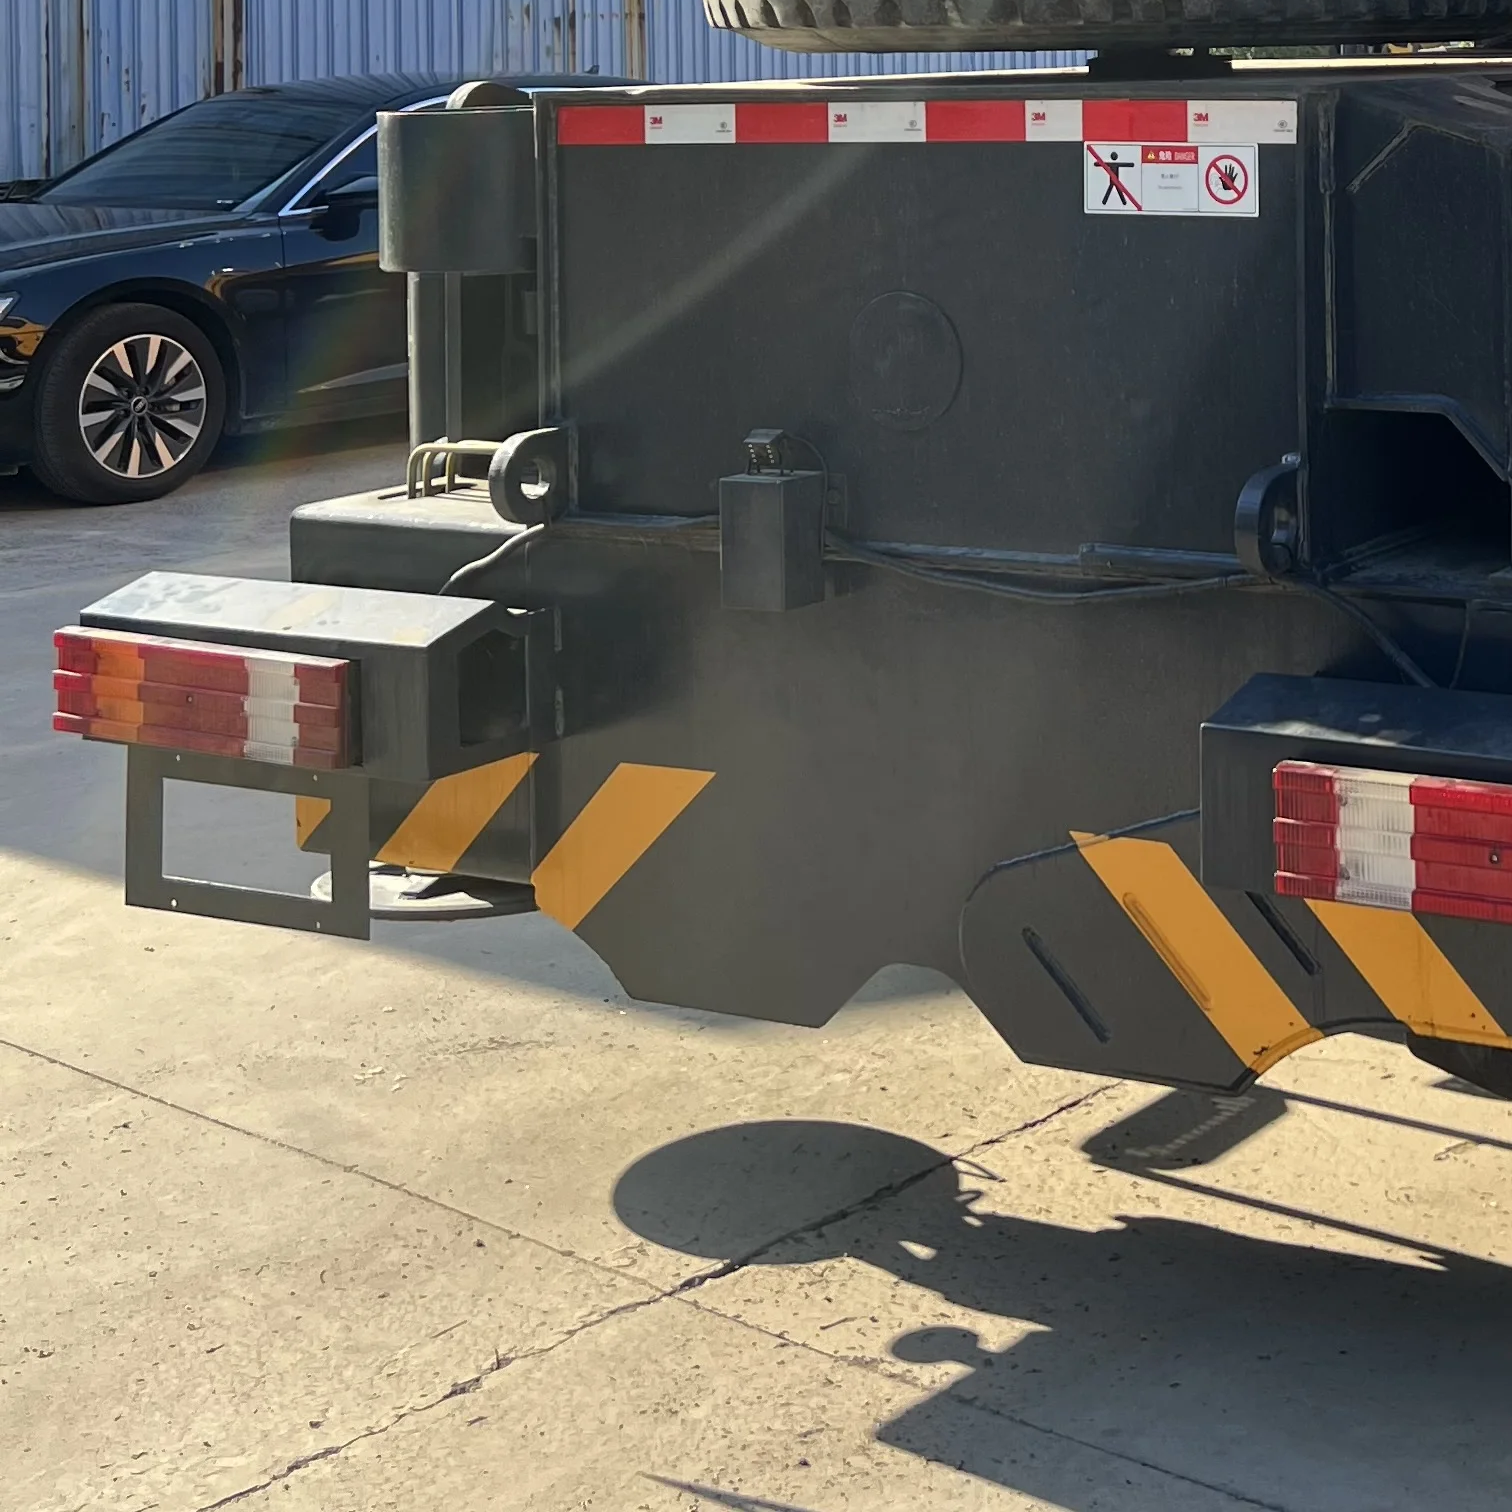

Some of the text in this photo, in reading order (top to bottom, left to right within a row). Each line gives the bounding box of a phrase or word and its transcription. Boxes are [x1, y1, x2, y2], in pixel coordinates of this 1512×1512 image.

[649, 116, 663, 125] 3M
[833, 113, 848, 123] 3M
[1031, 111, 1046, 121] 3M
[1193, 112, 1209, 122] 3M
